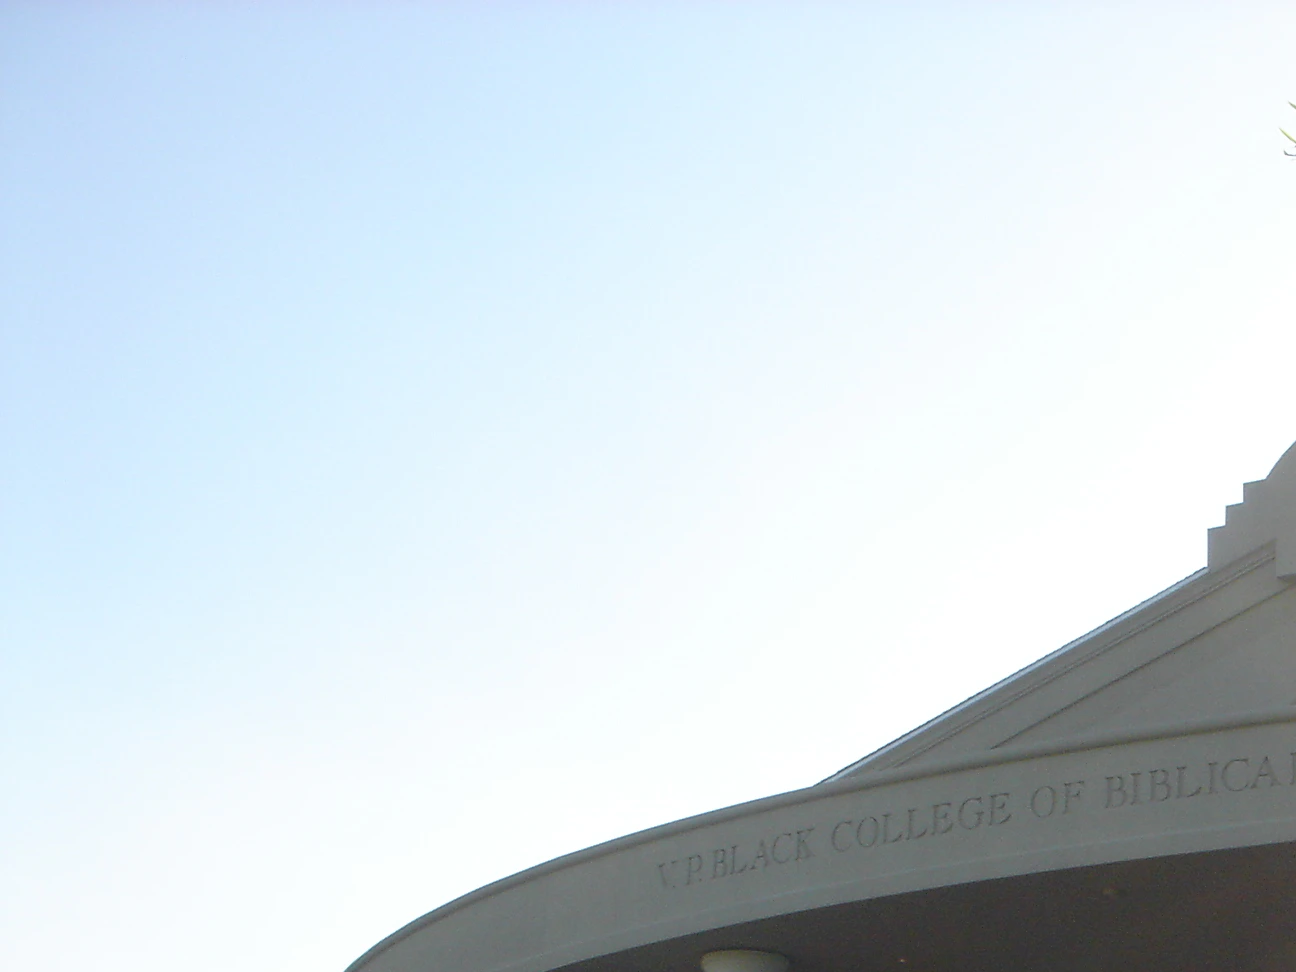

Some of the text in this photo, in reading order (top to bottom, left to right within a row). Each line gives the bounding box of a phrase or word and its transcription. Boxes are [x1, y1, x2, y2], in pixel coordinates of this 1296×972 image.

[710, 827, 816, 880] BLACK
[831, 792, 1012, 852] COLLEGE
[1031, 780, 1085, 818] OF
